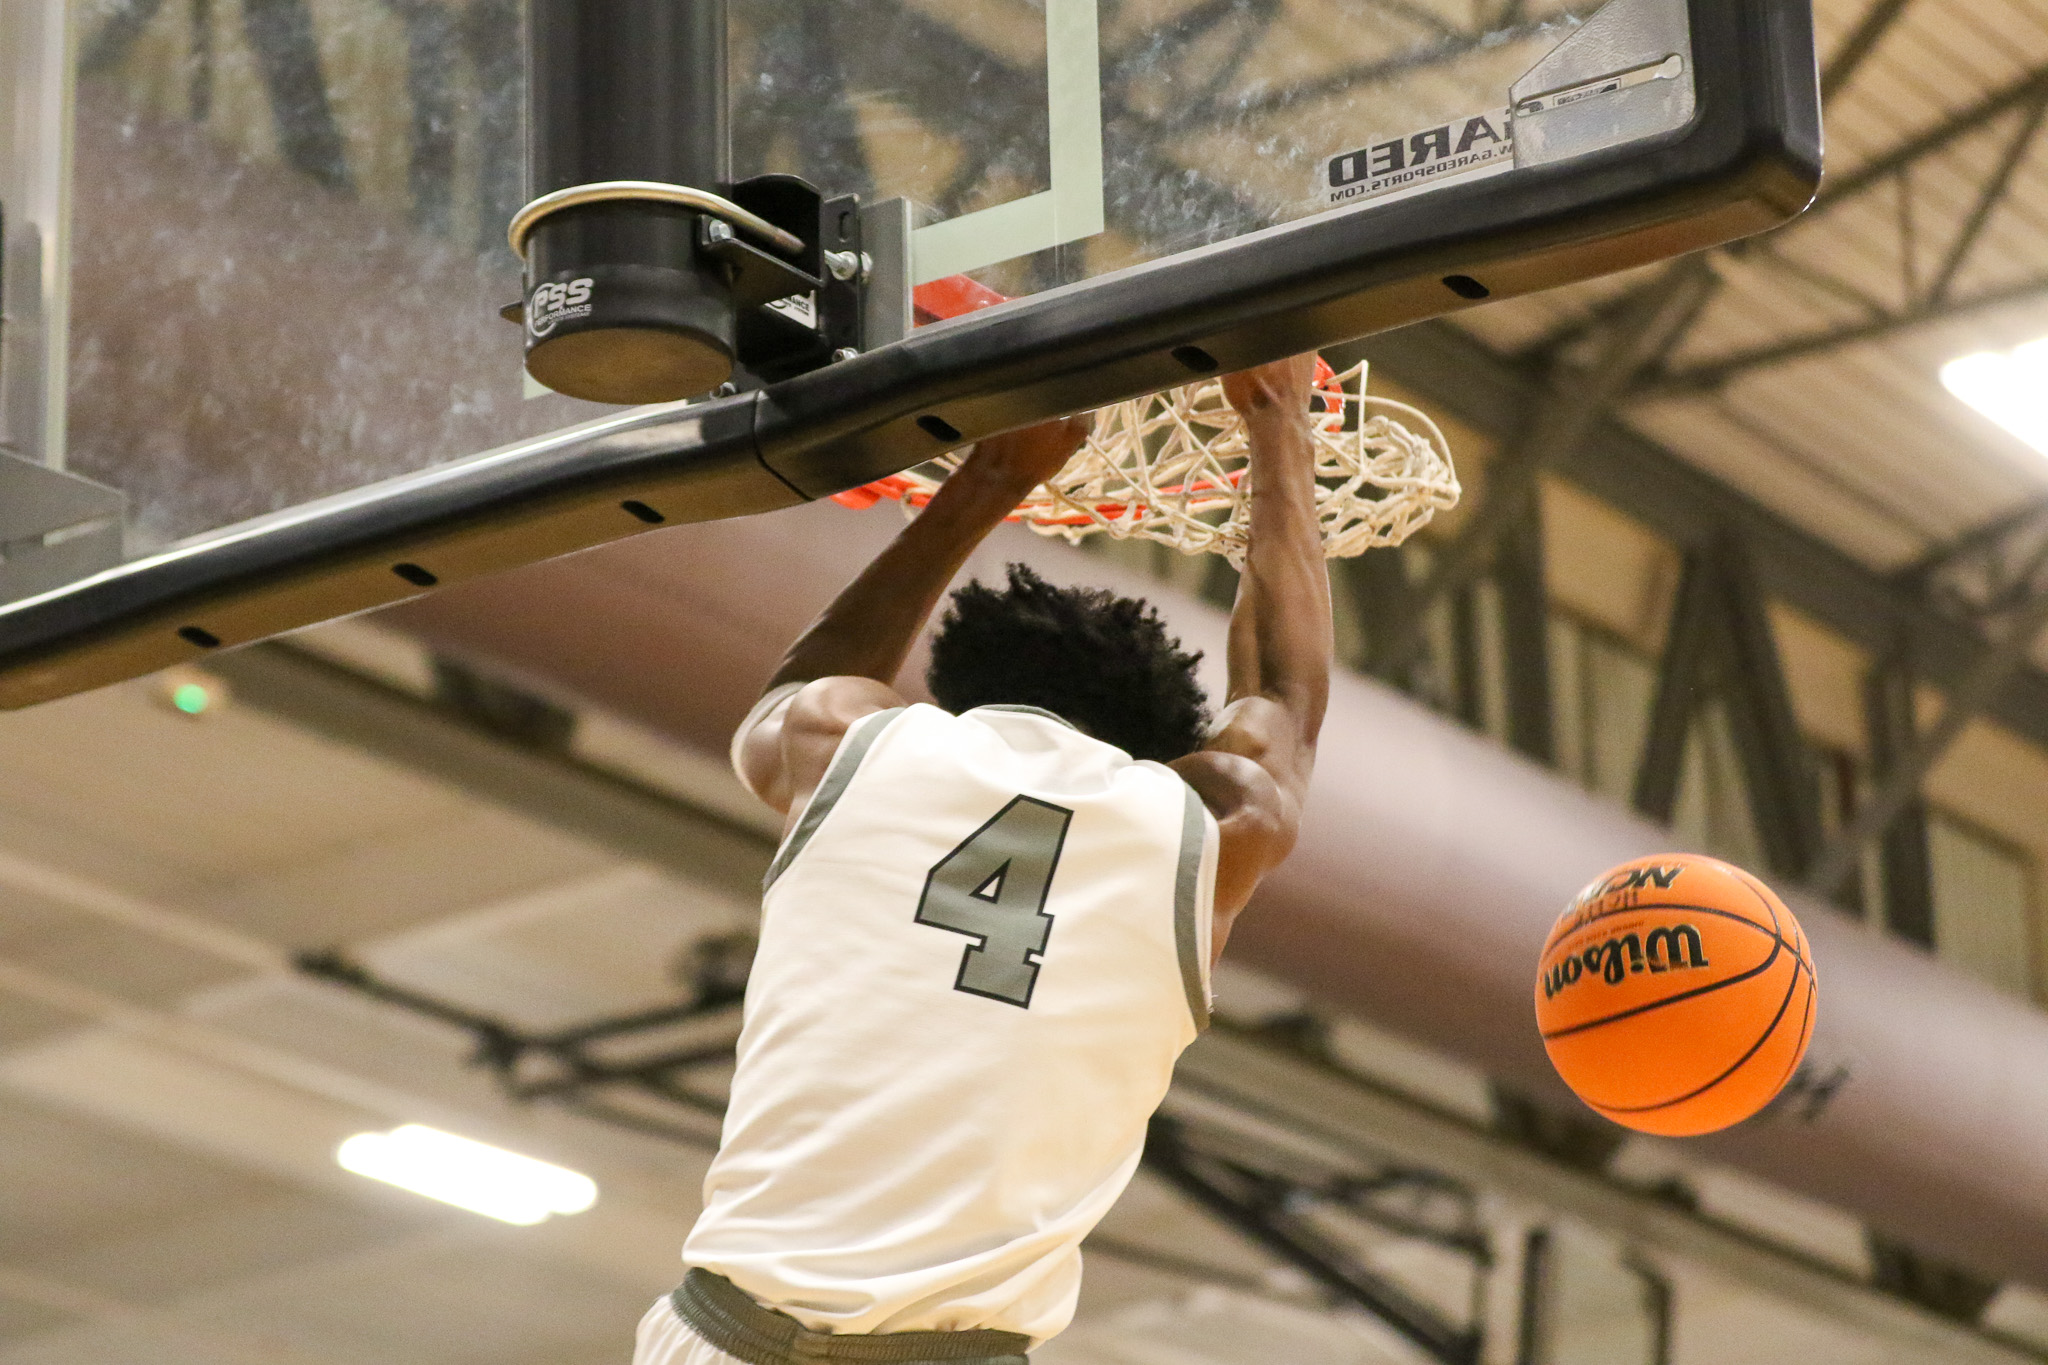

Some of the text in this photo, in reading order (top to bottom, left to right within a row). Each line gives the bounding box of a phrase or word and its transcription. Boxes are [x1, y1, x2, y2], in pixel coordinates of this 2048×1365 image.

[533, 278, 593, 319] PSS
[914, 793, 1074, 1009] 4
[1544, 923, 1709, 1000] Wilson
